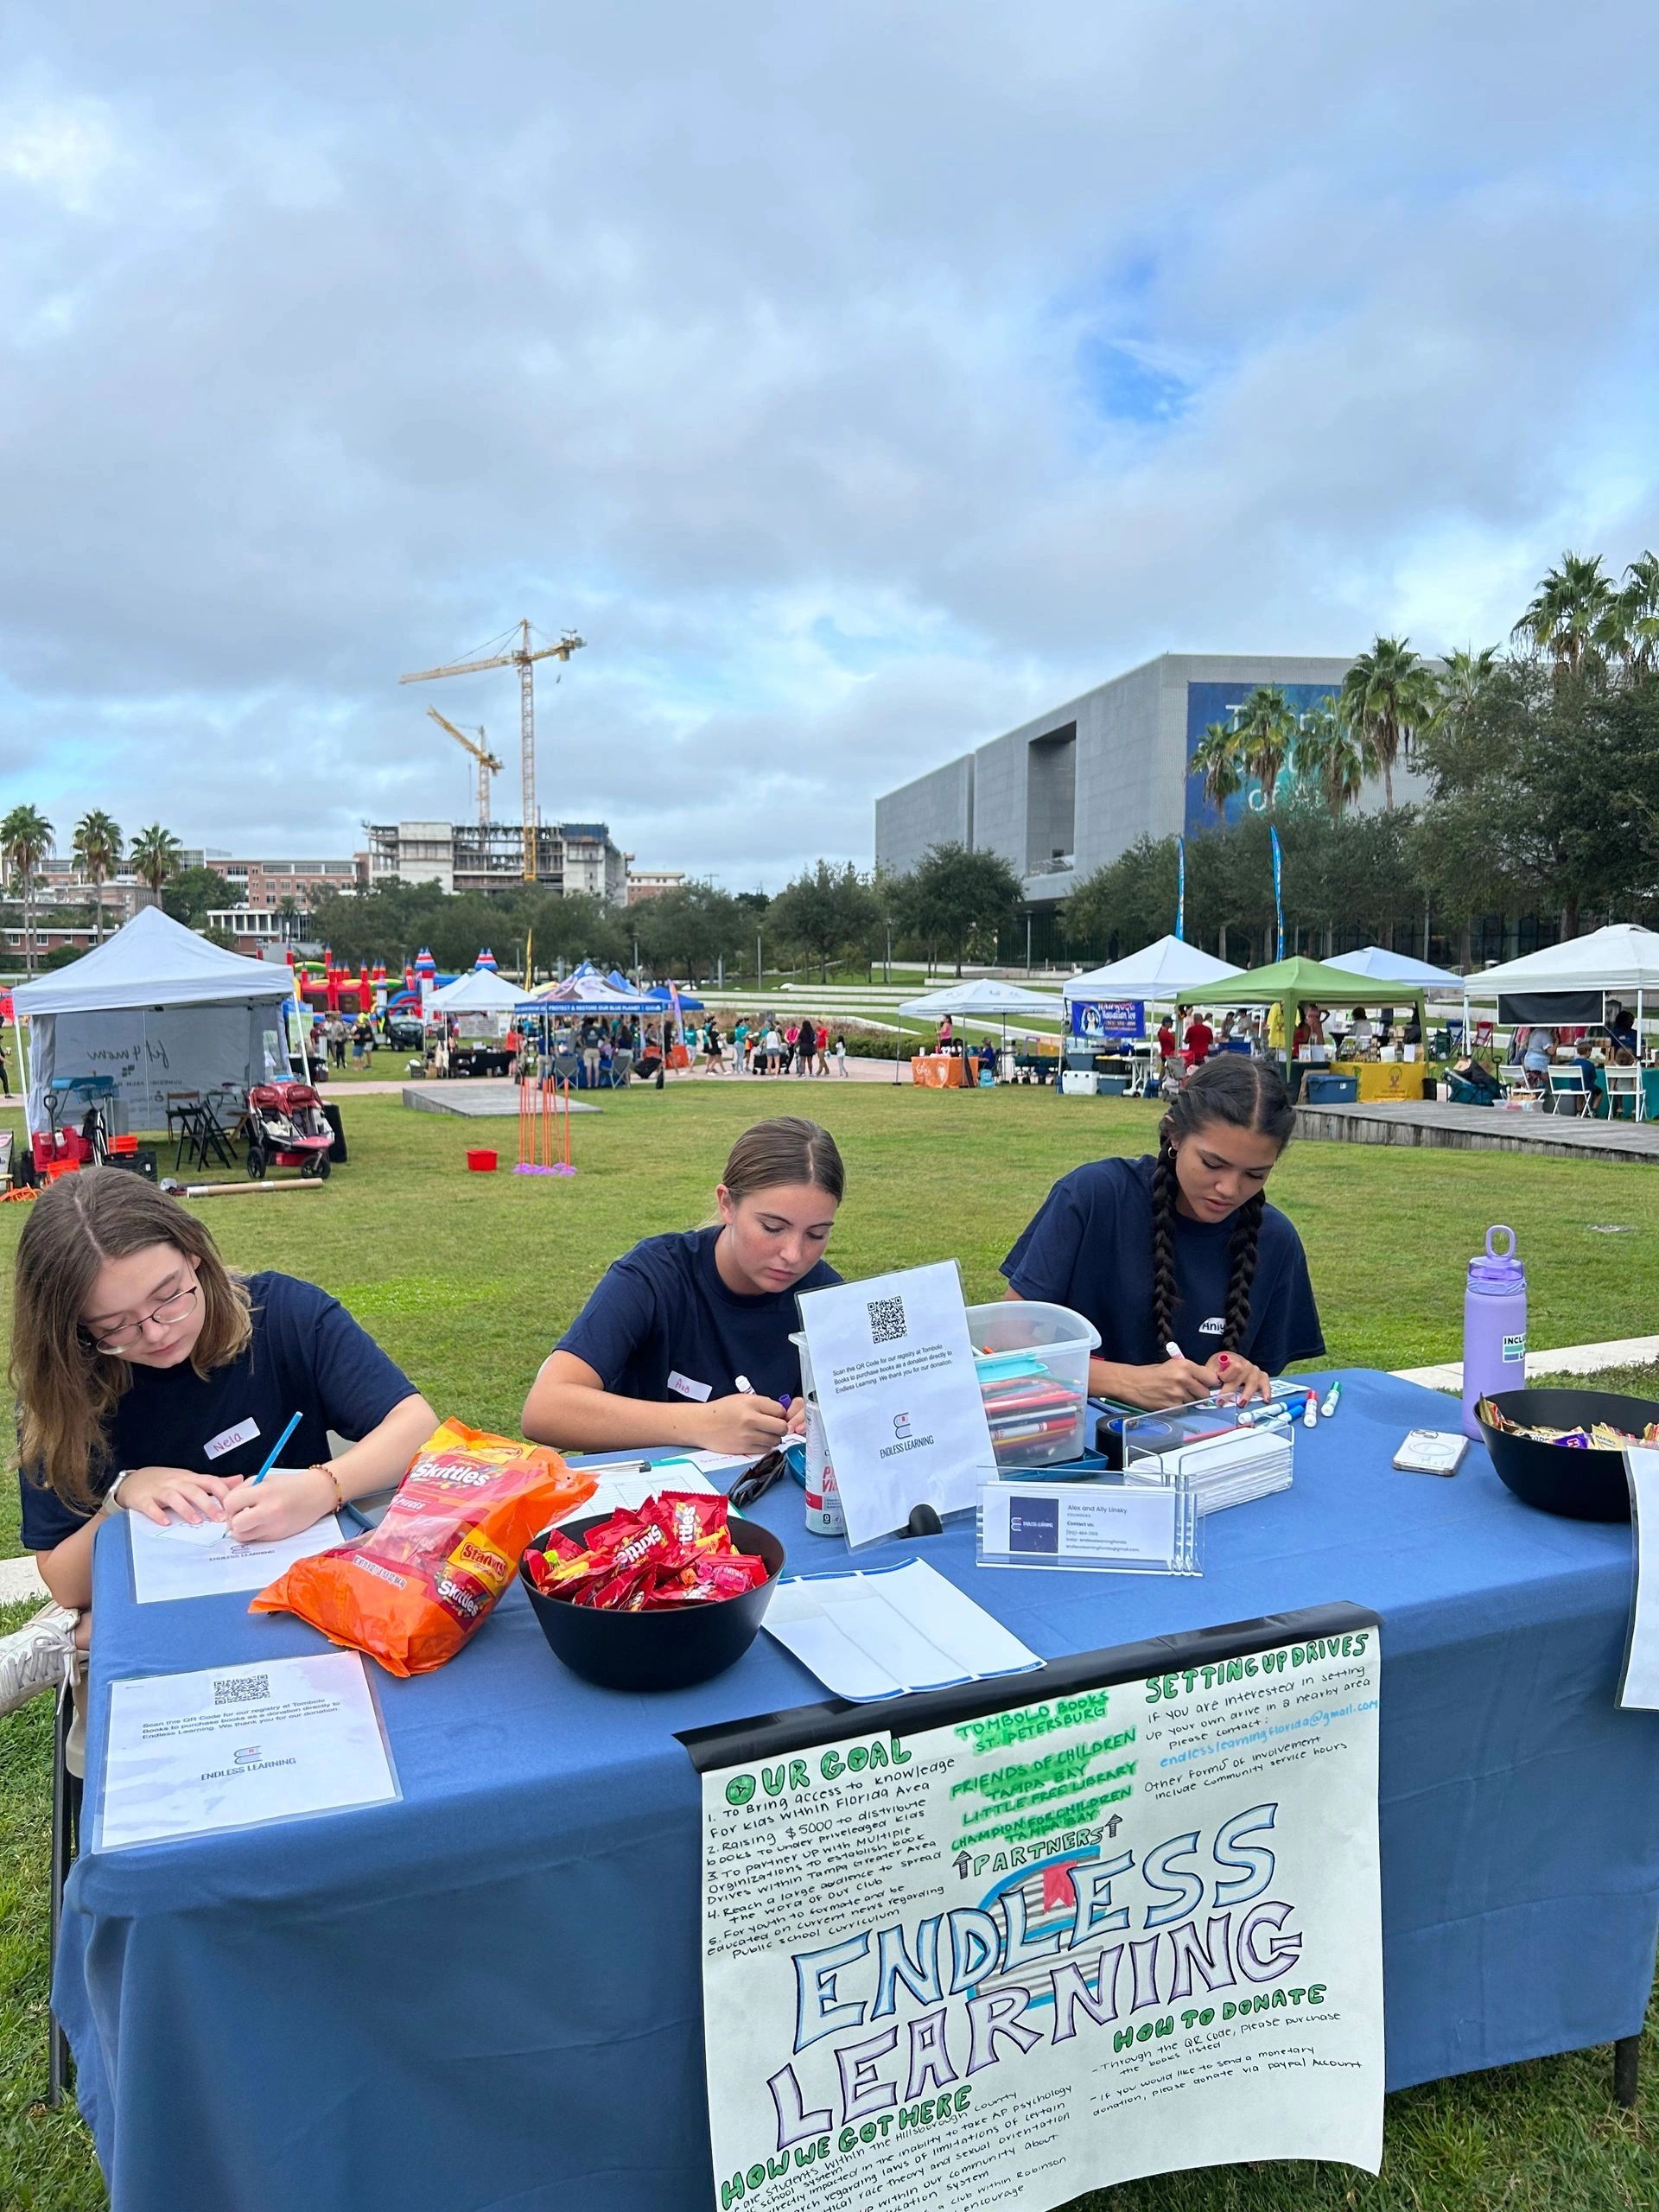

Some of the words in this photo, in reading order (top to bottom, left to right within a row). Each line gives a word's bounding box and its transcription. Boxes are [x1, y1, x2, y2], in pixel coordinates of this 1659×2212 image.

[834, 1377, 850, 1385] Books
[856, 1369, 879, 1379] purchase
[907, 1356, 928, 1366] donation
[897, 1352, 915, 1360] registry
[921, 1344, 942, 1353] Tombolo
[836, 1384, 855, 1394] Endless
[889, 1371, 902, 1379] thank
[213, 1432, 243, 1452] Nela
[880, 1443, 904, 1458] ENDLESS
[904, 1435, 934, 1451] LEARNING
[410, 1463, 491, 1486] Skittles
[438, 1579, 479, 1617] Skittles
[1145, 1657, 1258, 1703] SETTING
[1262, 1651, 1288, 1673] UP
[1292, 1634, 1369, 1667] DRIVES
[1196, 1700, 1219, 1713] are
[1225, 1680, 1295, 1707] interested
[1302, 1677, 1314, 1685] in
[1322, 1665, 1365, 1683] setting
[957, 1705, 1050, 1738] TOMBOLO
[976, 1739, 1001, 1752] ST.
[1007, 1709, 1106, 1742] PETERSBURG
[1168, 1723, 1195, 1735] your
[1201, 1715, 1226, 1727] own
[1230, 1706, 1260, 1720] drive
[1267, 1703, 1276, 1711] in
[1283, 1699, 1290, 1708] a
[1296, 1686, 1338, 1704] nearby
[1344, 1678, 1371, 1690] area
[201, 1767, 245, 1780] ENDLESS
[248, 1758, 296, 1771] LEARNING
[725, 1759, 810, 1806] OUR
[820, 1738, 912, 1780] GOAL
[952, 1765, 1028, 1797] FRIENDS
[1034, 1756, 1053, 1770] OF
[1057, 1729, 1136, 1765] CHILDREN
[986, 1780, 1045, 1800] TAMPA
[1054, 1764, 1087, 1782] BAY
[1144, 1775, 1183, 1792] Other
[1252, 1735, 1321, 1762] involvement
[1155, 1783, 1197, 1800] include
[1203, 1764, 1264, 1786] community
[1270, 1752, 1307, 1766] service
[1313, 1742, 1348, 1755] hours
[708, 1814, 716, 1822] 1.
[746, 1797, 788, 1816] Bring
[795, 1785, 841, 1804] access
[846, 1781, 863, 1792] to
[875, 1757, 955, 1786] knowledge
[710, 1824, 737, 1839] For
[780, 1803, 830, 1820] within
[836, 1790, 889, 1809] Florida
[895, 1781, 930, 1797] Area
[963, 1796, 1025, 1824] LITTLE
[1032, 1784, 1068, 1804] FREE
[1071, 1761, 1137, 1790] LIBRARY
[951, 1818, 1024, 1851] CHAMPION
[1028, 1813, 1056, 1827] FOR
[1057, 1786, 1133, 1818] CHILDREN
[1005, 1821, 1060, 1842] TAMPA
[1065, 1810, 1100, 1826] BAY
[973, 1826, 1104, 1876] PARTNERS
[778, 1929, 821, 1945] school
[828, 1909, 900, 1935] curriculum
[792, 1802, 1279, 2054] ENDLESS
[766, 1900, 1303, 2152] LEARNING
[1113, 2015, 1175, 2053] HOW
[1181, 2008, 1215, 2029] TO
[1222, 1984, 1327, 2020] DONATE
[1157, 2042, 1178, 2056] the
[1184, 2035, 1203, 2050] QR
[1285, 2012, 1342, 2027] purchase
[1120, 2065, 1140, 2075] the
[1149, 2053, 1182, 2067] books
[1189, 2041, 1222, 2056] listed
[721, 2149, 790, 2211] HOW
[794, 2136, 831, 2168] WE
[838, 2114, 894, 2153] GOT
[899, 2085, 972, 2130] HERE
[766, 2168, 819, 2197] students
[825, 2148, 865, 2171] within
[869, 2139, 890, 2151] the
[896, 2111, 968, 2142] Hillsborough
[974, 2092, 1017, 2112] county
